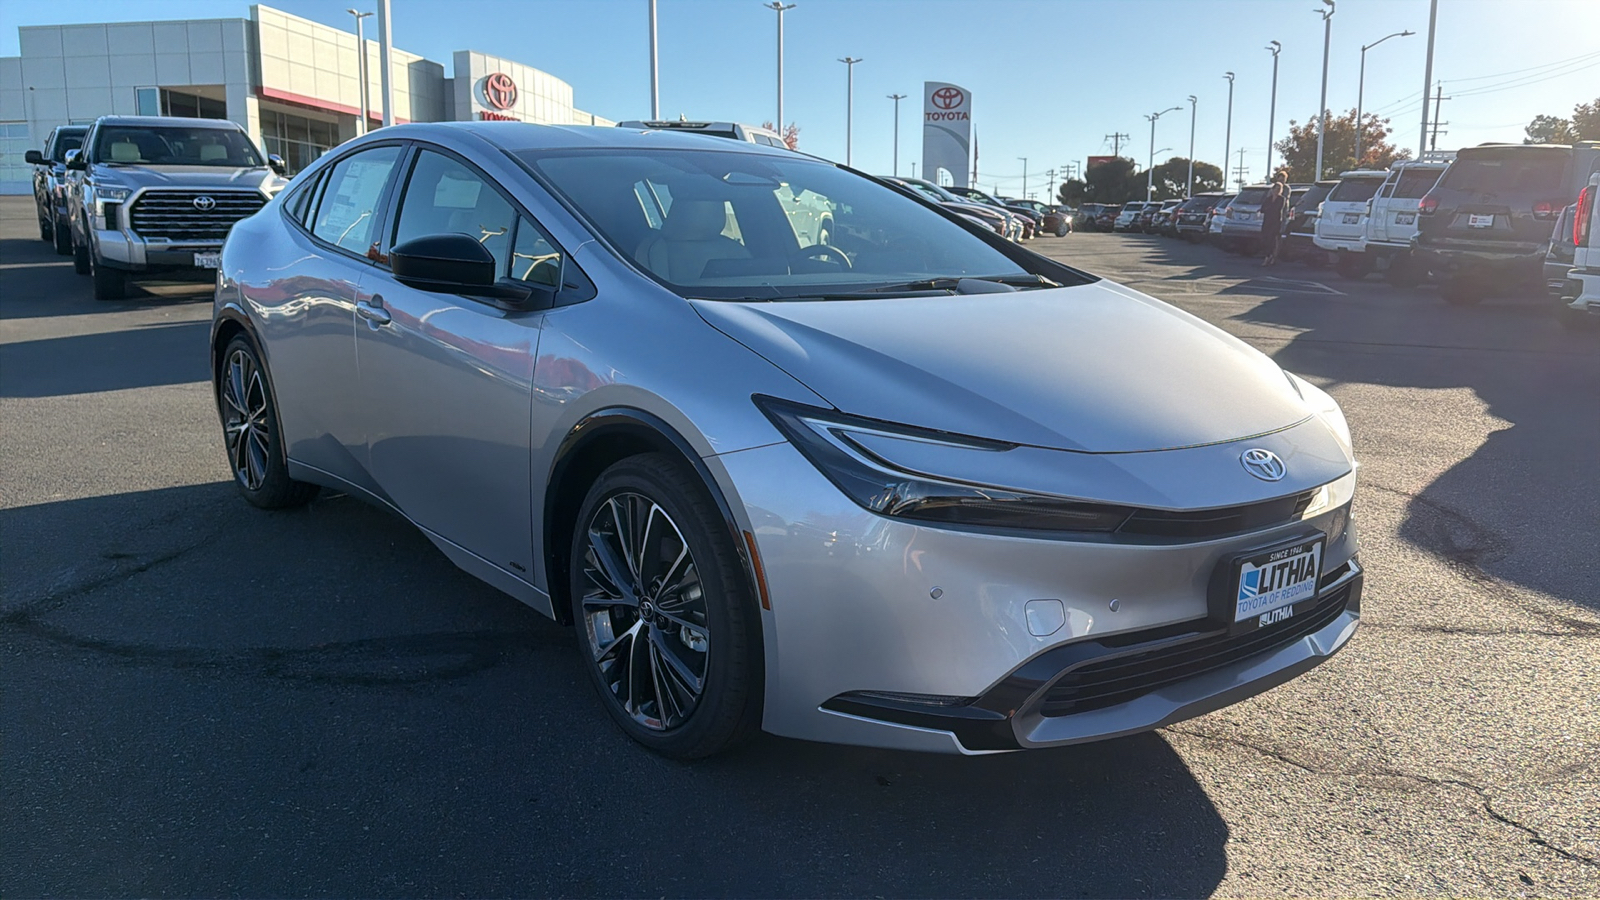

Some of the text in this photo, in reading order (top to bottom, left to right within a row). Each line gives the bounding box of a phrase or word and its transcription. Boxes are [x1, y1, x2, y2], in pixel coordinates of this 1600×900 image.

[925, 111, 969, 121] TOYOTA
[1269, 549, 1289, 562] SINCE
[1258, 554, 1315, 594] LITHIA
[1238, 580, 1314, 614] TOYOTA OF REDDING
[1266, 605, 1293, 625] LITHIA
